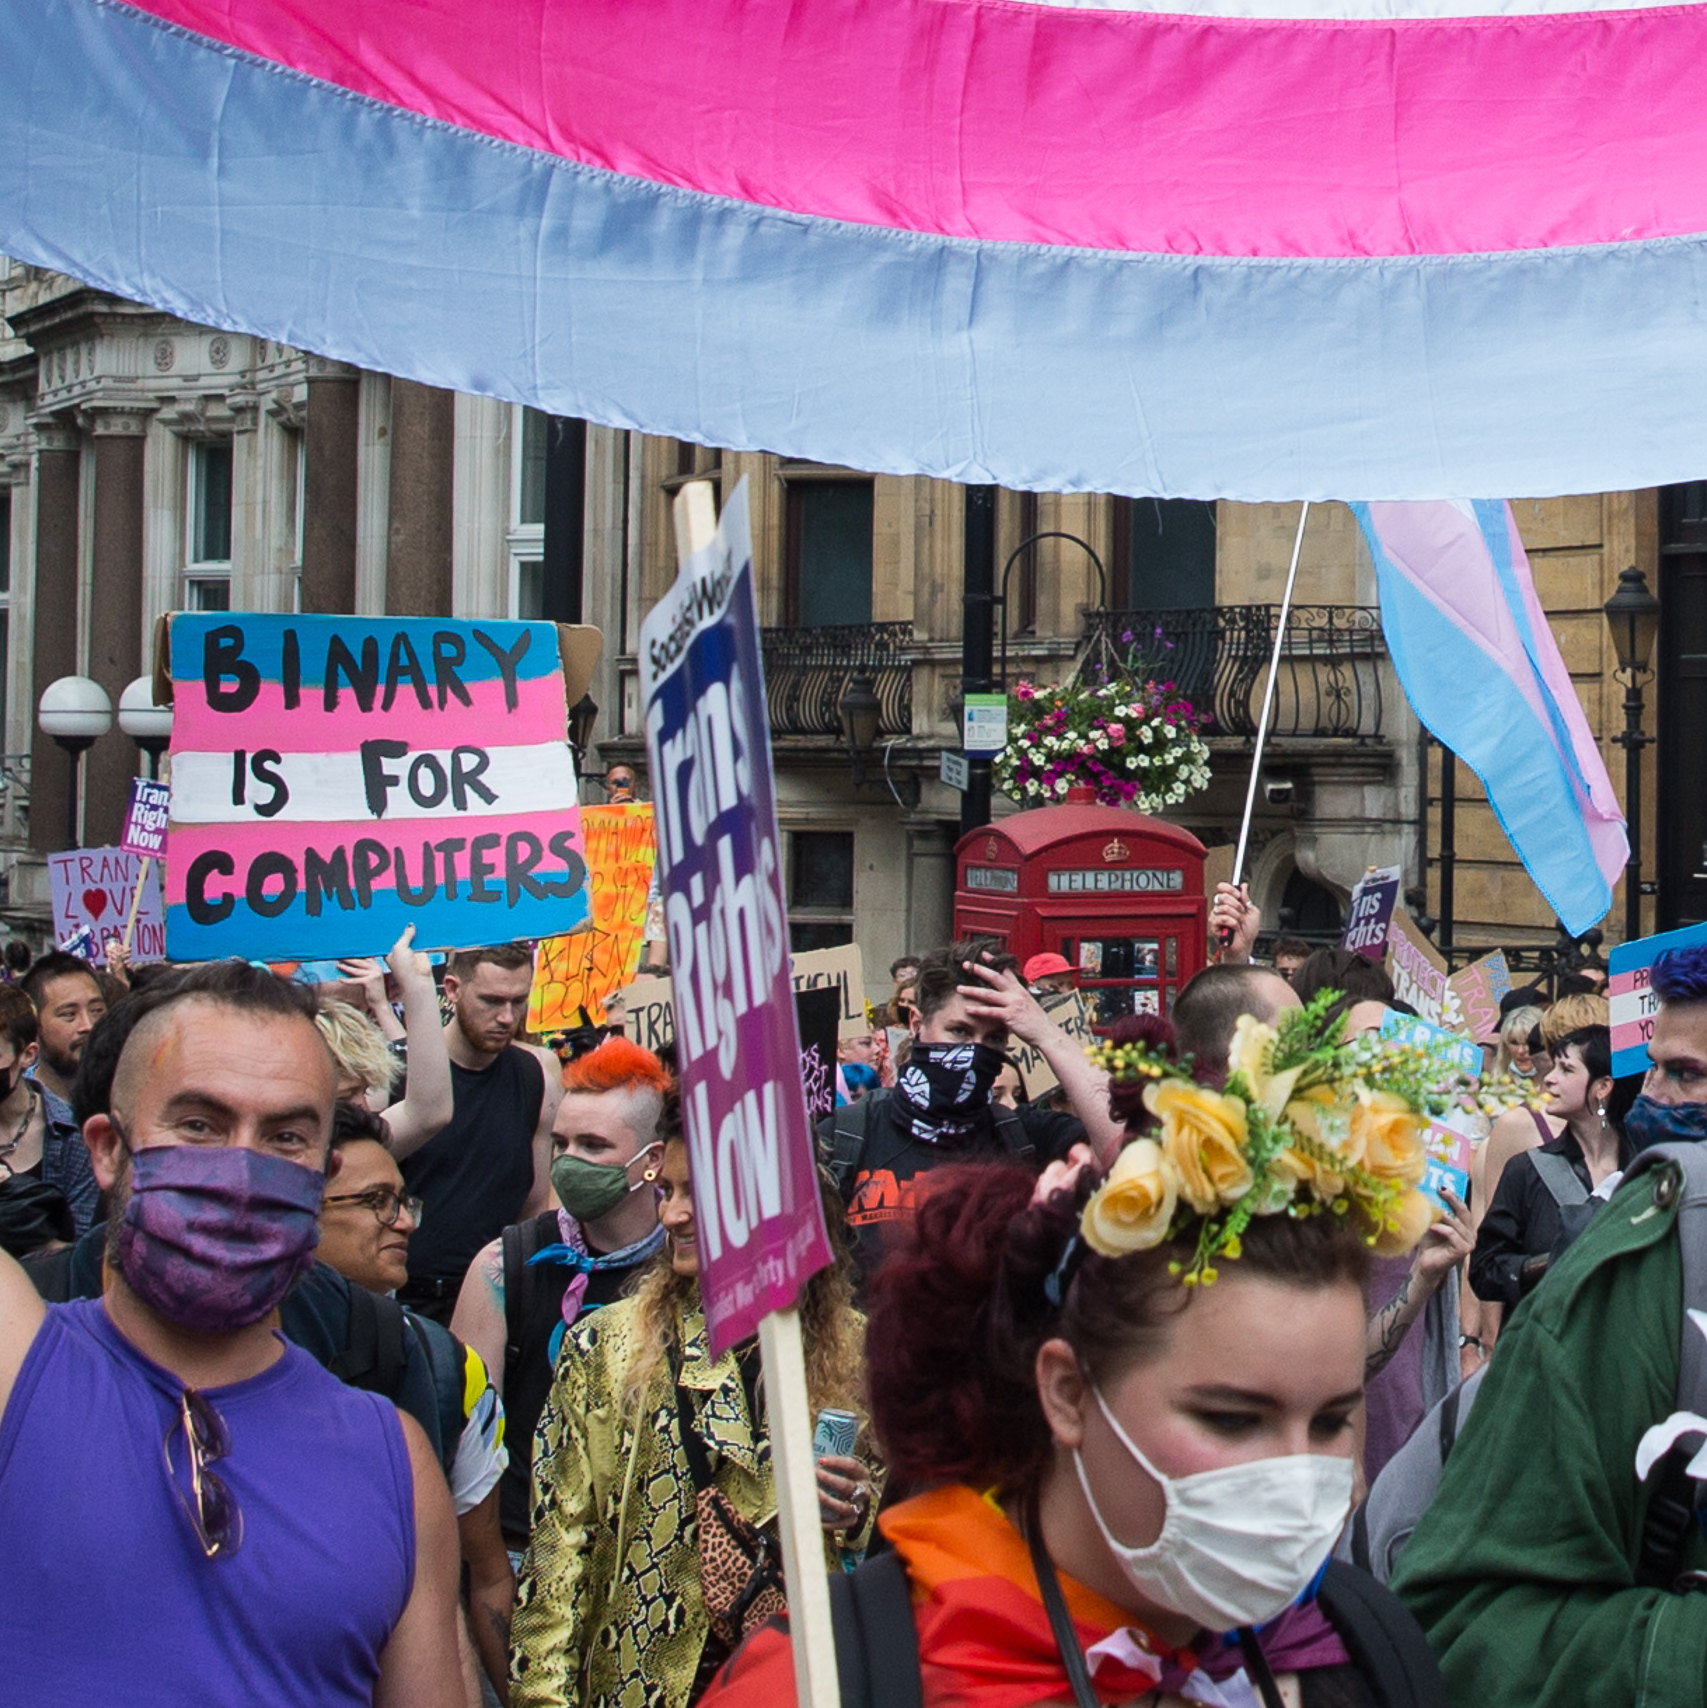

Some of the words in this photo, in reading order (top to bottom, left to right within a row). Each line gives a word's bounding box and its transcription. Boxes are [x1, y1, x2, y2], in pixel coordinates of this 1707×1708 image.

[203, 624, 532, 715] BINARY
[135, 781, 169, 805] Tran
[232, 748, 290, 818] IS
[360, 739, 500, 821] FOR
[131, 804, 169, 831] Righ
[126, 824, 163, 850] Now
[185, 830, 588, 926] COMPUTERS
[1051, 871, 1179, 890] TELEPHONE
